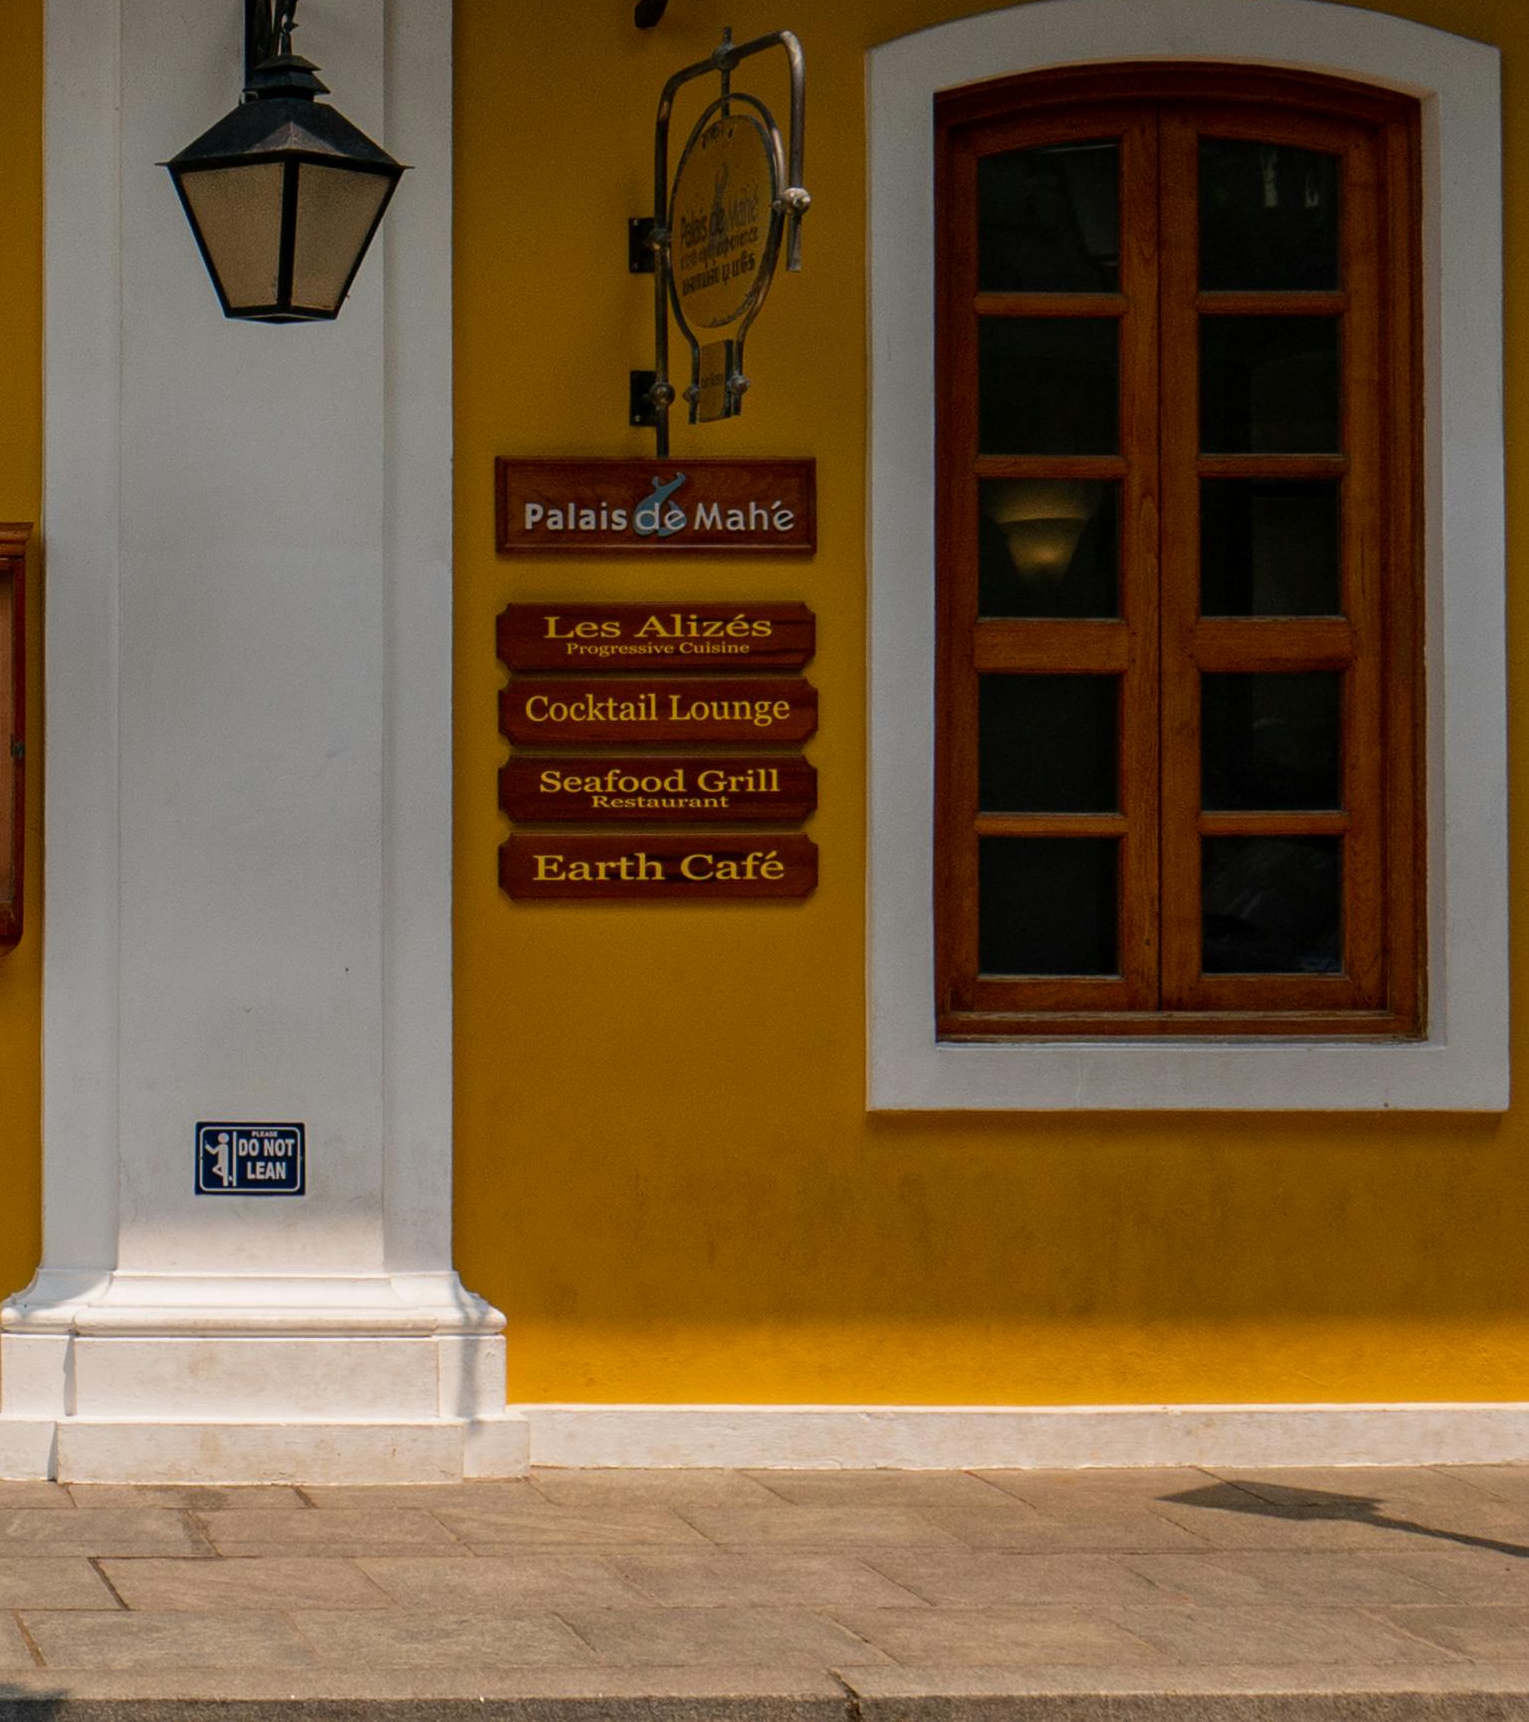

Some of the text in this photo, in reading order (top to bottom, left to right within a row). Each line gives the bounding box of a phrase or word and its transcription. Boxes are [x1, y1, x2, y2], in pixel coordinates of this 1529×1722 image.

[524, 500, 795, 532] Palais de Mahé
[543, 614, 773, 639] Les Alizés
[566, 641, 751, 657] Progressive Cuisine
[525, 694, 791, 727] Cocktail Lounge
[539, 769, 781, 793] Seafood Grill
[591, 794, 730, 809] Restaurant
[532, 850, 785, 881] Earth Café
[238, 1138, 295, 1157] DO NOT
[246, 1161, 286, 1180] LEAN
